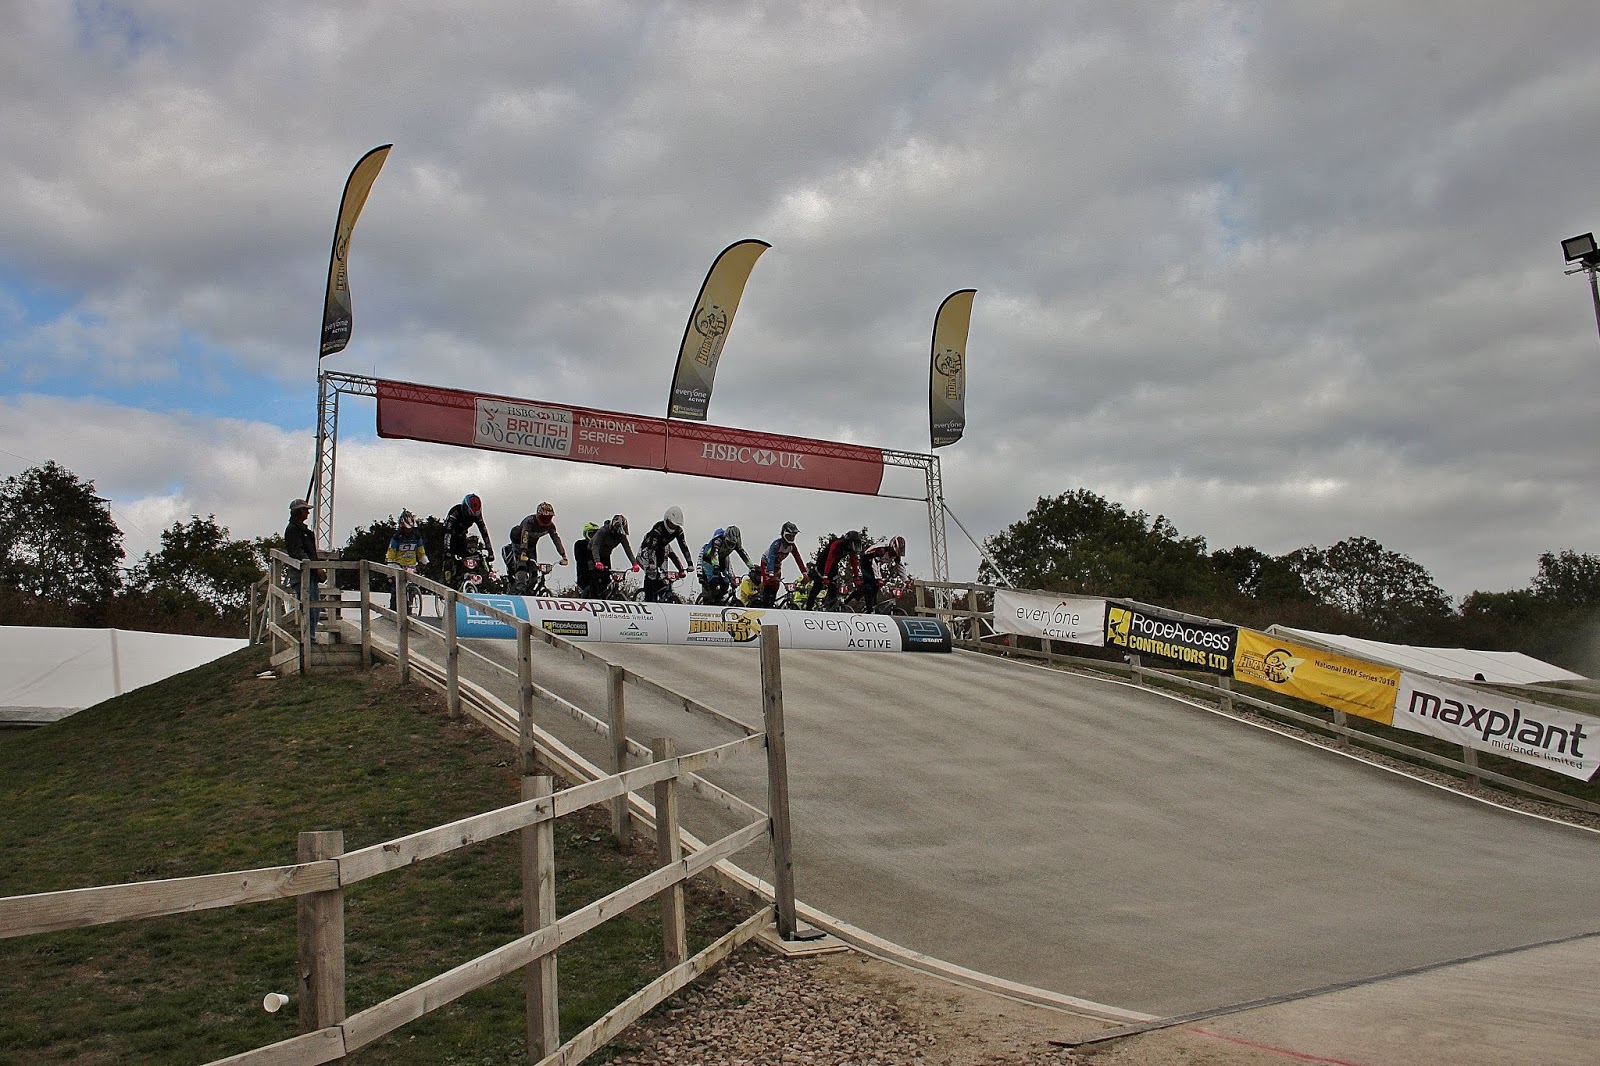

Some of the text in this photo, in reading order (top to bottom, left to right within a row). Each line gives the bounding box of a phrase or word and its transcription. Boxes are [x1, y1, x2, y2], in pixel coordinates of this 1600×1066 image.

[676, 389, 707, 398] everyone
[507, 406, 568, 424] HSBC UK
[506, 418, 568, 438] BRITISH
[579, 416, 639, 435] NATIONAL
[505, 432, 567, 450] CYCLING
[578, 430, 625, 445] SERIES
[577, 444, 599, 456] BMX
[700, 442, 805, 470] HSBC UK
[537, 599, 652, 617] maxplant
[1016, 603, 1080, 627] everyone
[552, 621, 587, 630] RopeAccess
[689, 620, 747, 633] HORNETS
[804, 614, 889, 636] everyone
[1042, 627, 1078, 639] ACTIVE
[1131, 612, 1231, 651] RopeAccess
[848, 638, 892, 649] ACTIVE
[1129, 634, 1229, 671] CONTRACTORS LTD
[1314, 660, 1396, 687] National BMX Series 2018
[1409, 689, 1588, 758] maxplant
[1491, 738, 1583, 770] midlands limited
